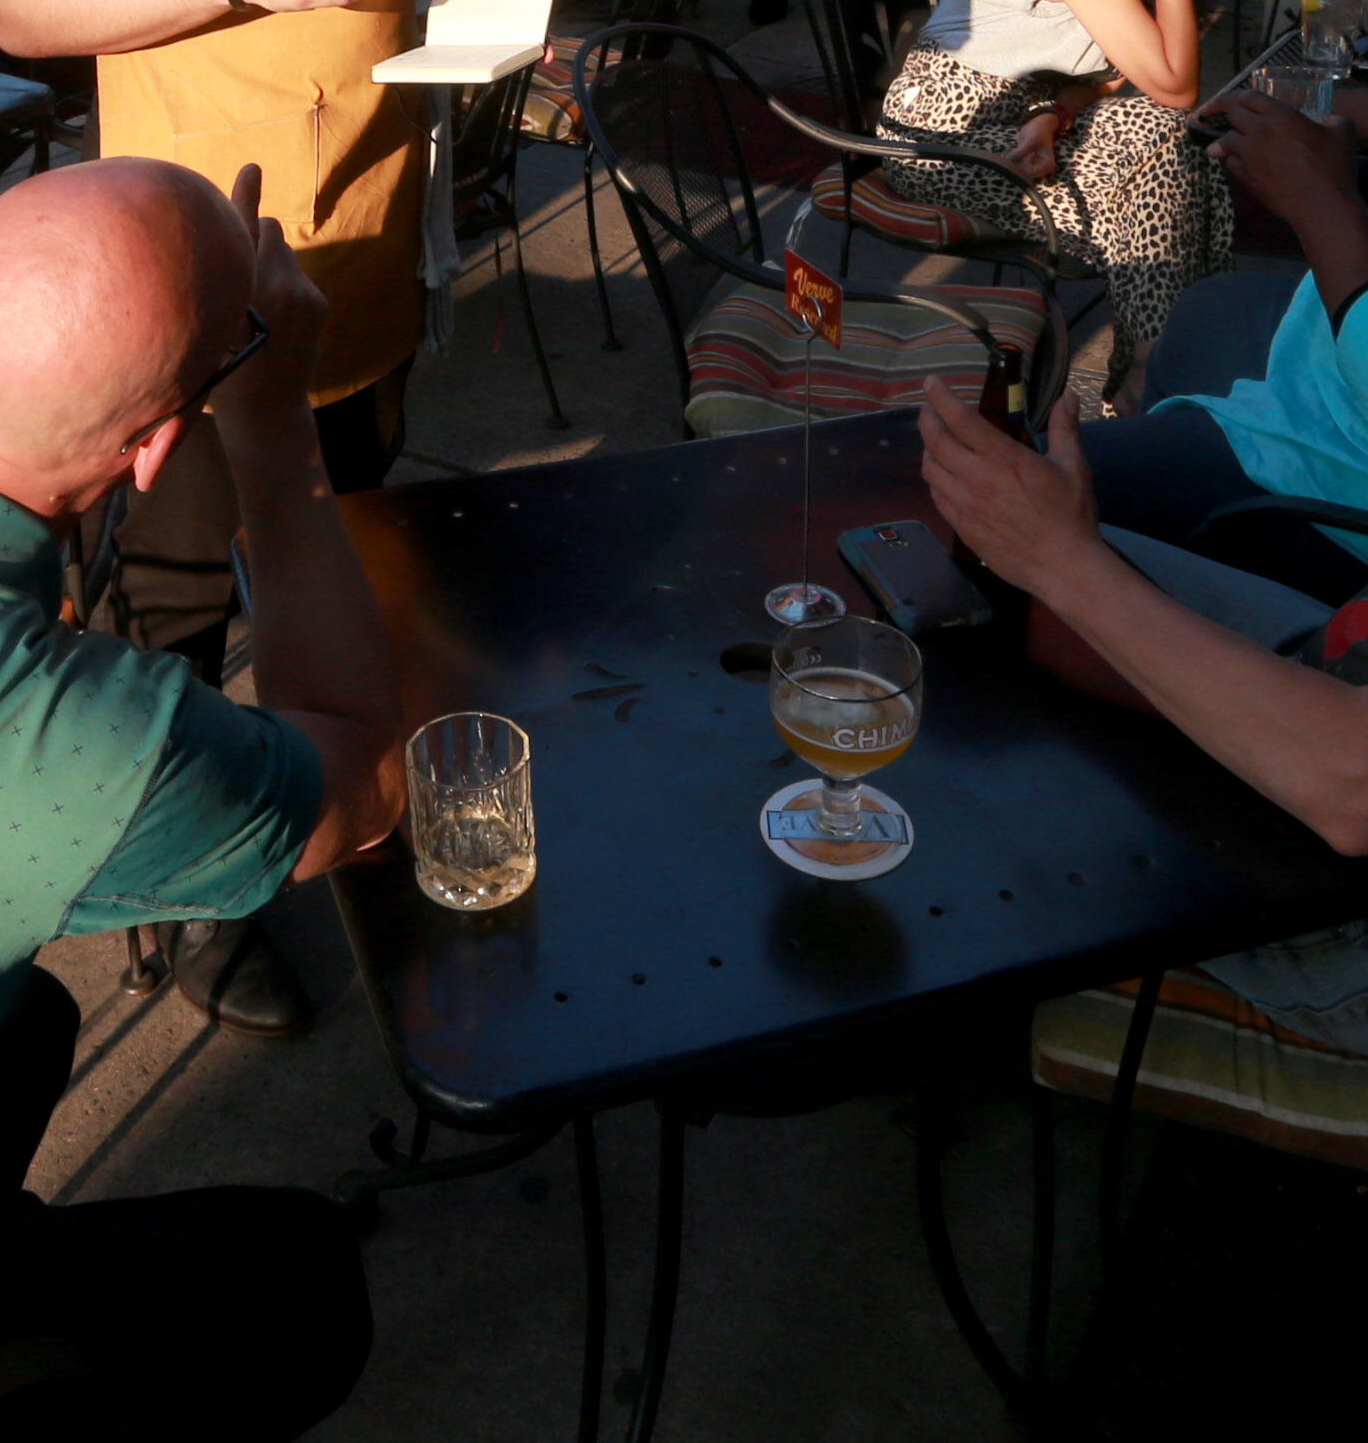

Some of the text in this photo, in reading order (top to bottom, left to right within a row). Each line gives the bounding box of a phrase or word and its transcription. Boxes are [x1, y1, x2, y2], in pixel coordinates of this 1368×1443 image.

[792, 267, 836, 304] Verve
[790, 292, 838, 342] Rsered
[778, 814, 891, 839] VVE
